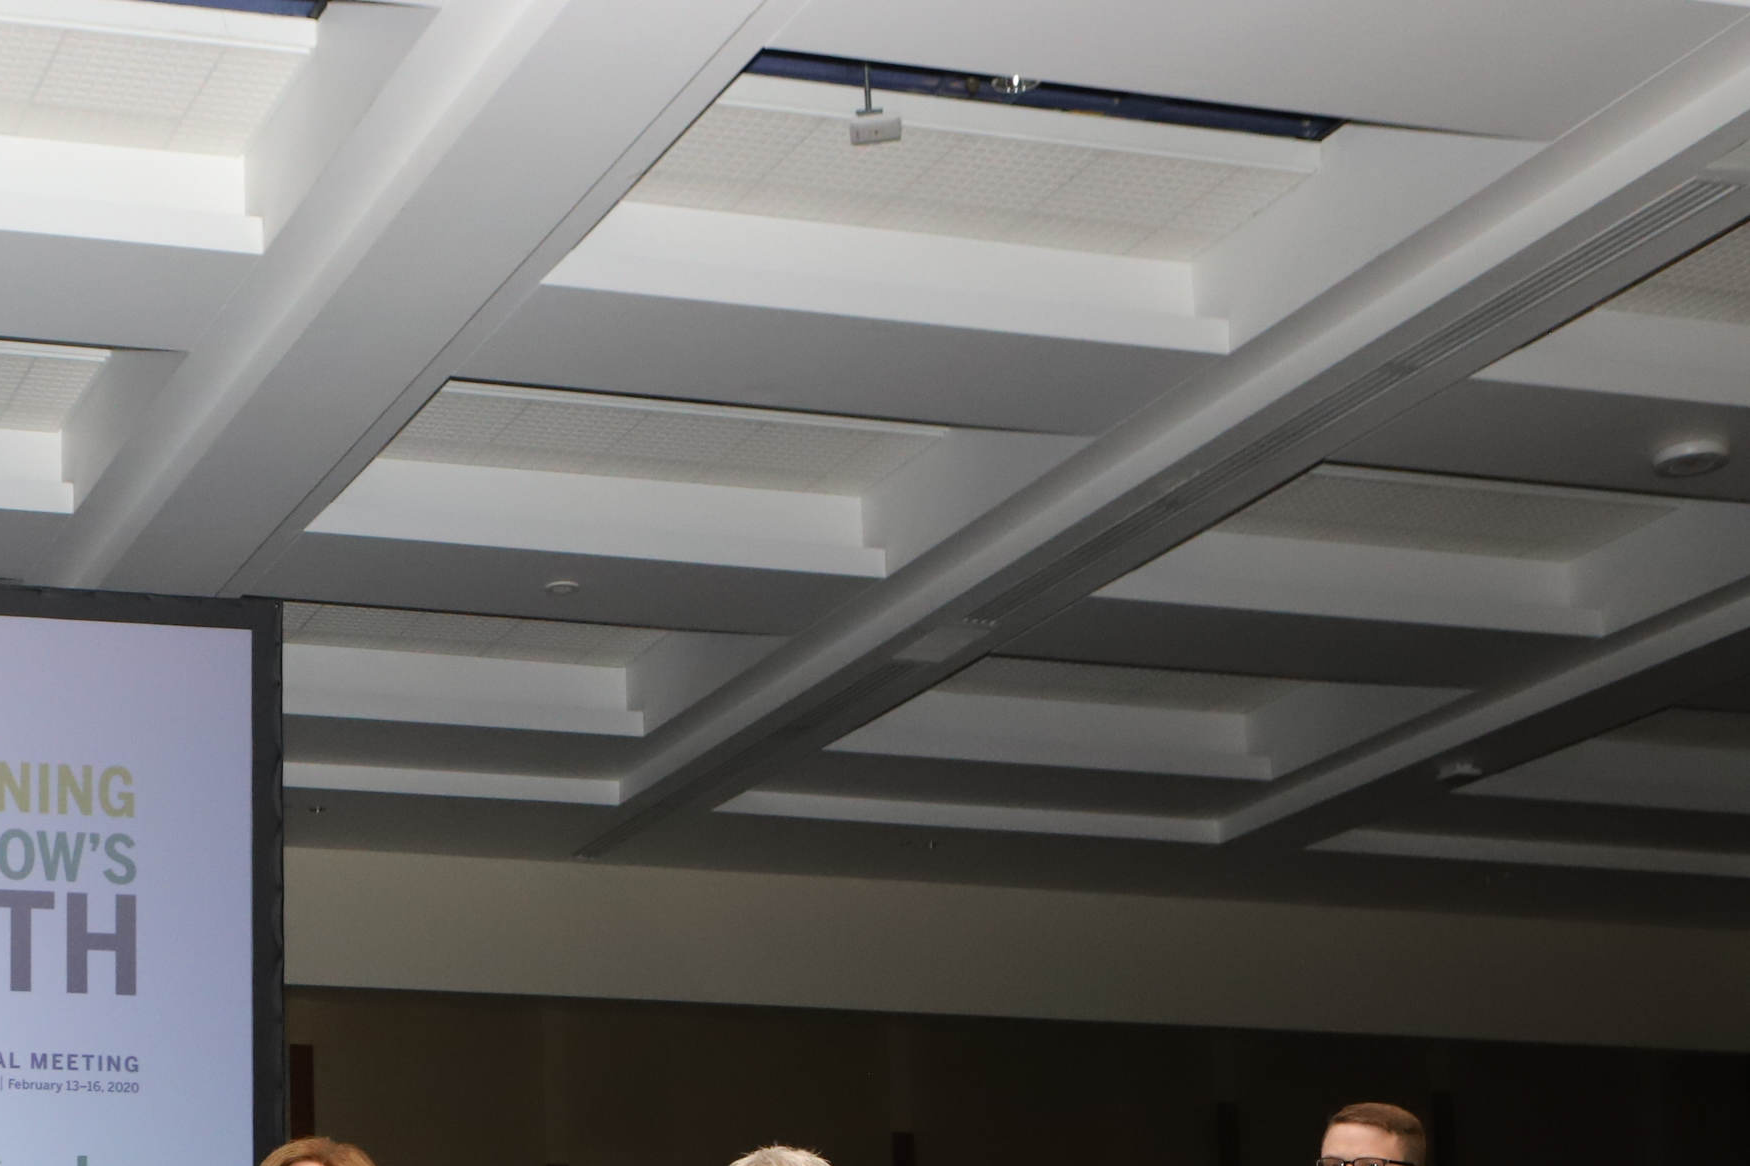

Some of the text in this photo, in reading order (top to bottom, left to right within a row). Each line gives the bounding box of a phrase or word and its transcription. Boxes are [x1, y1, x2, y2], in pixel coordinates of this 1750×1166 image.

[30, 1052, 140, 1073] MEETING
[8, 1079, 62, 1093] February
[107, 1081, 140, 1094] 2020
